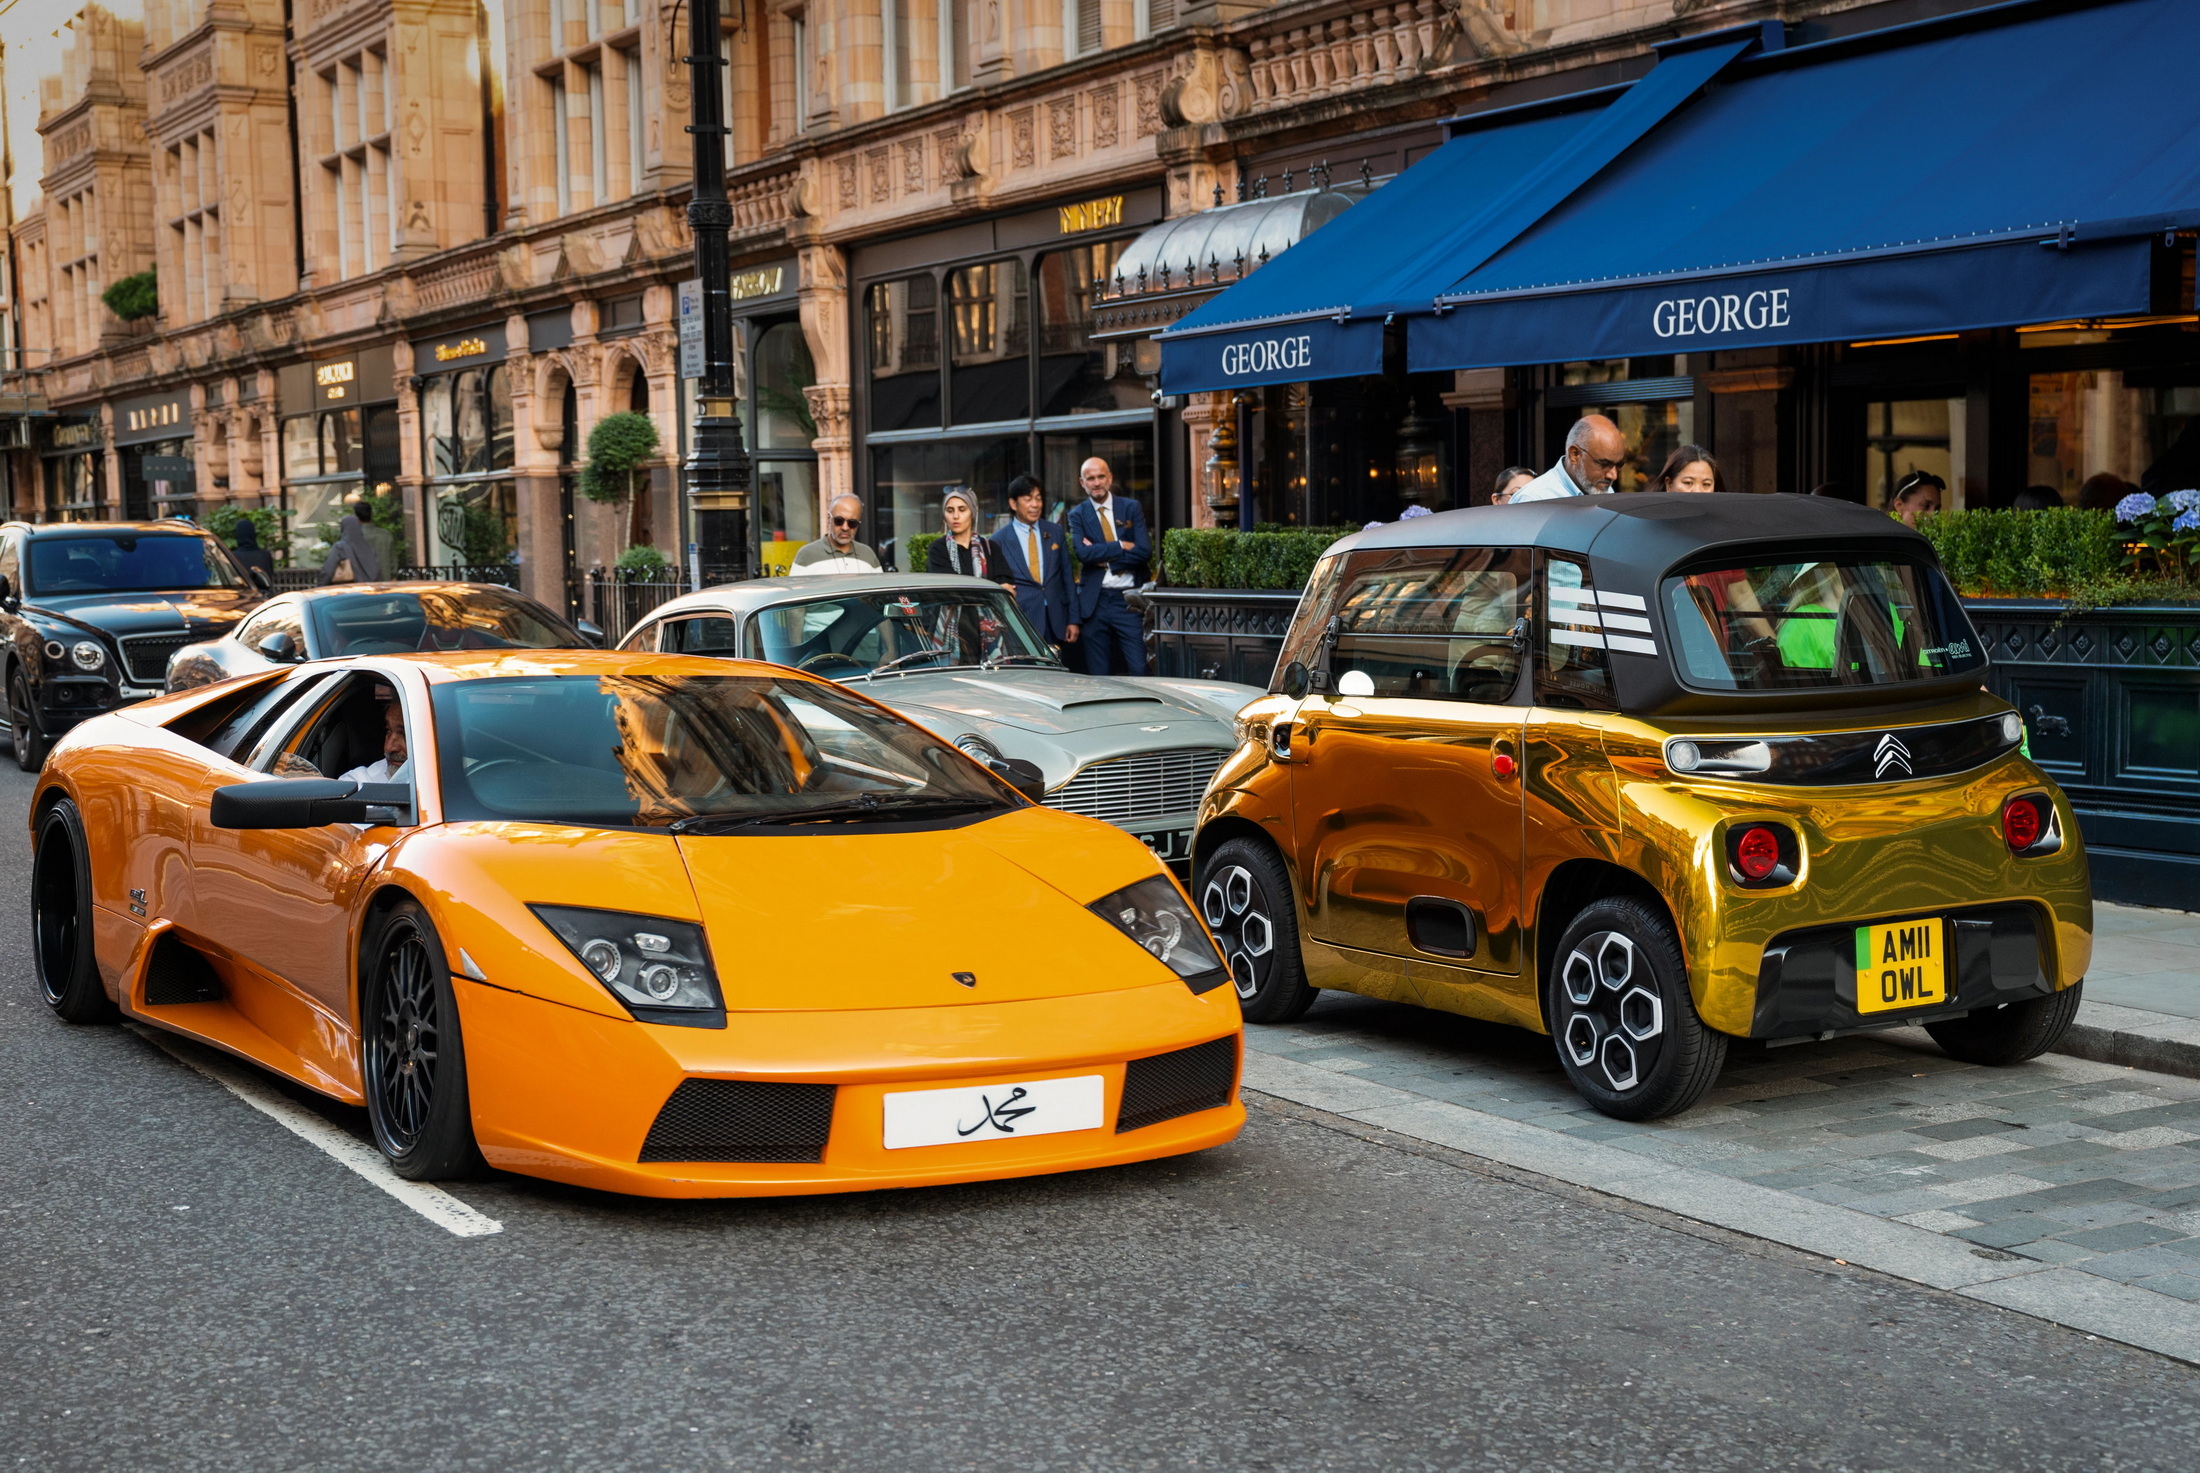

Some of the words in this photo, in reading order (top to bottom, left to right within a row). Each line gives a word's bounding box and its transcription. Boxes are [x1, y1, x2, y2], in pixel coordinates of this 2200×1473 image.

[1653, 288, 1791, 338] GEORGE
[1222, 335, 1312, 376] GEORGE
[1881, 965, 1934, 1003] OWL
[957, 1086, 1037, 1137] محمد
